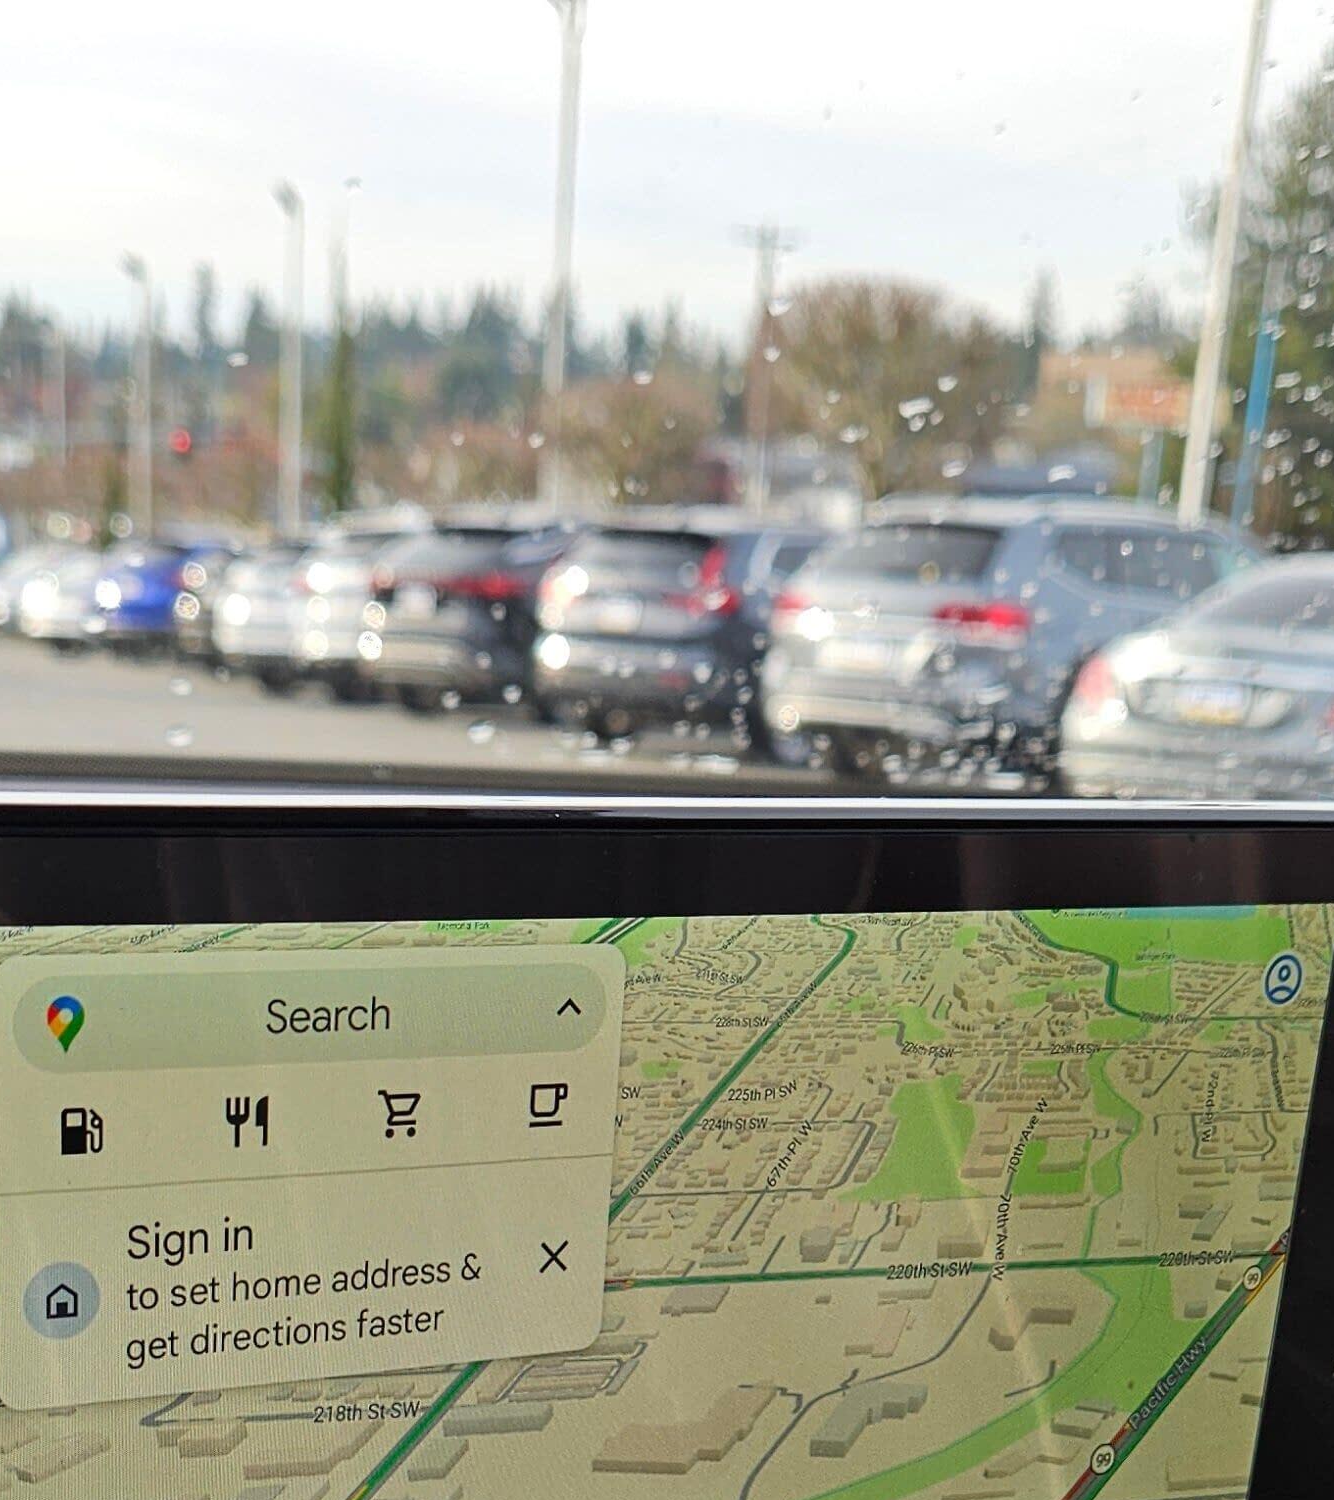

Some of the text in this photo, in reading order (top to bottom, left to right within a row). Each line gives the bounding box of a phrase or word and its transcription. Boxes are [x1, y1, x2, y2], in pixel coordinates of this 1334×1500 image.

[266, 994, 391, 1035] Search
[621, 1086, 641, 1099] SW
[728, 1087, 761, 1101] 225th
[779, 1080, 799, 1098] SW
[702, 1117, 769, 1131] 224th St SW
[1007, 1097, 1048, 1174] 70th Ave W
[652, 1144, 674, 1170] Ave
[670, 1131, 685, 1147] W
[767, 1153, 792, 1188] 67th
[797, 1119, 813, 1137] W
[127, 1216, 254, 1266] Sign in
[992, 1193, 1012, 1281] 70th Ave W
[126, 1252, 482, 1312] to set home address &
[887, 1262, 972, 1280] 220th St SW
[126, 1305, 444, 1368] get directions faster
[1128, 1336, 1209, 1430] Pacific Hwy
[313, 1401, 420, 1424] 218th St SW
